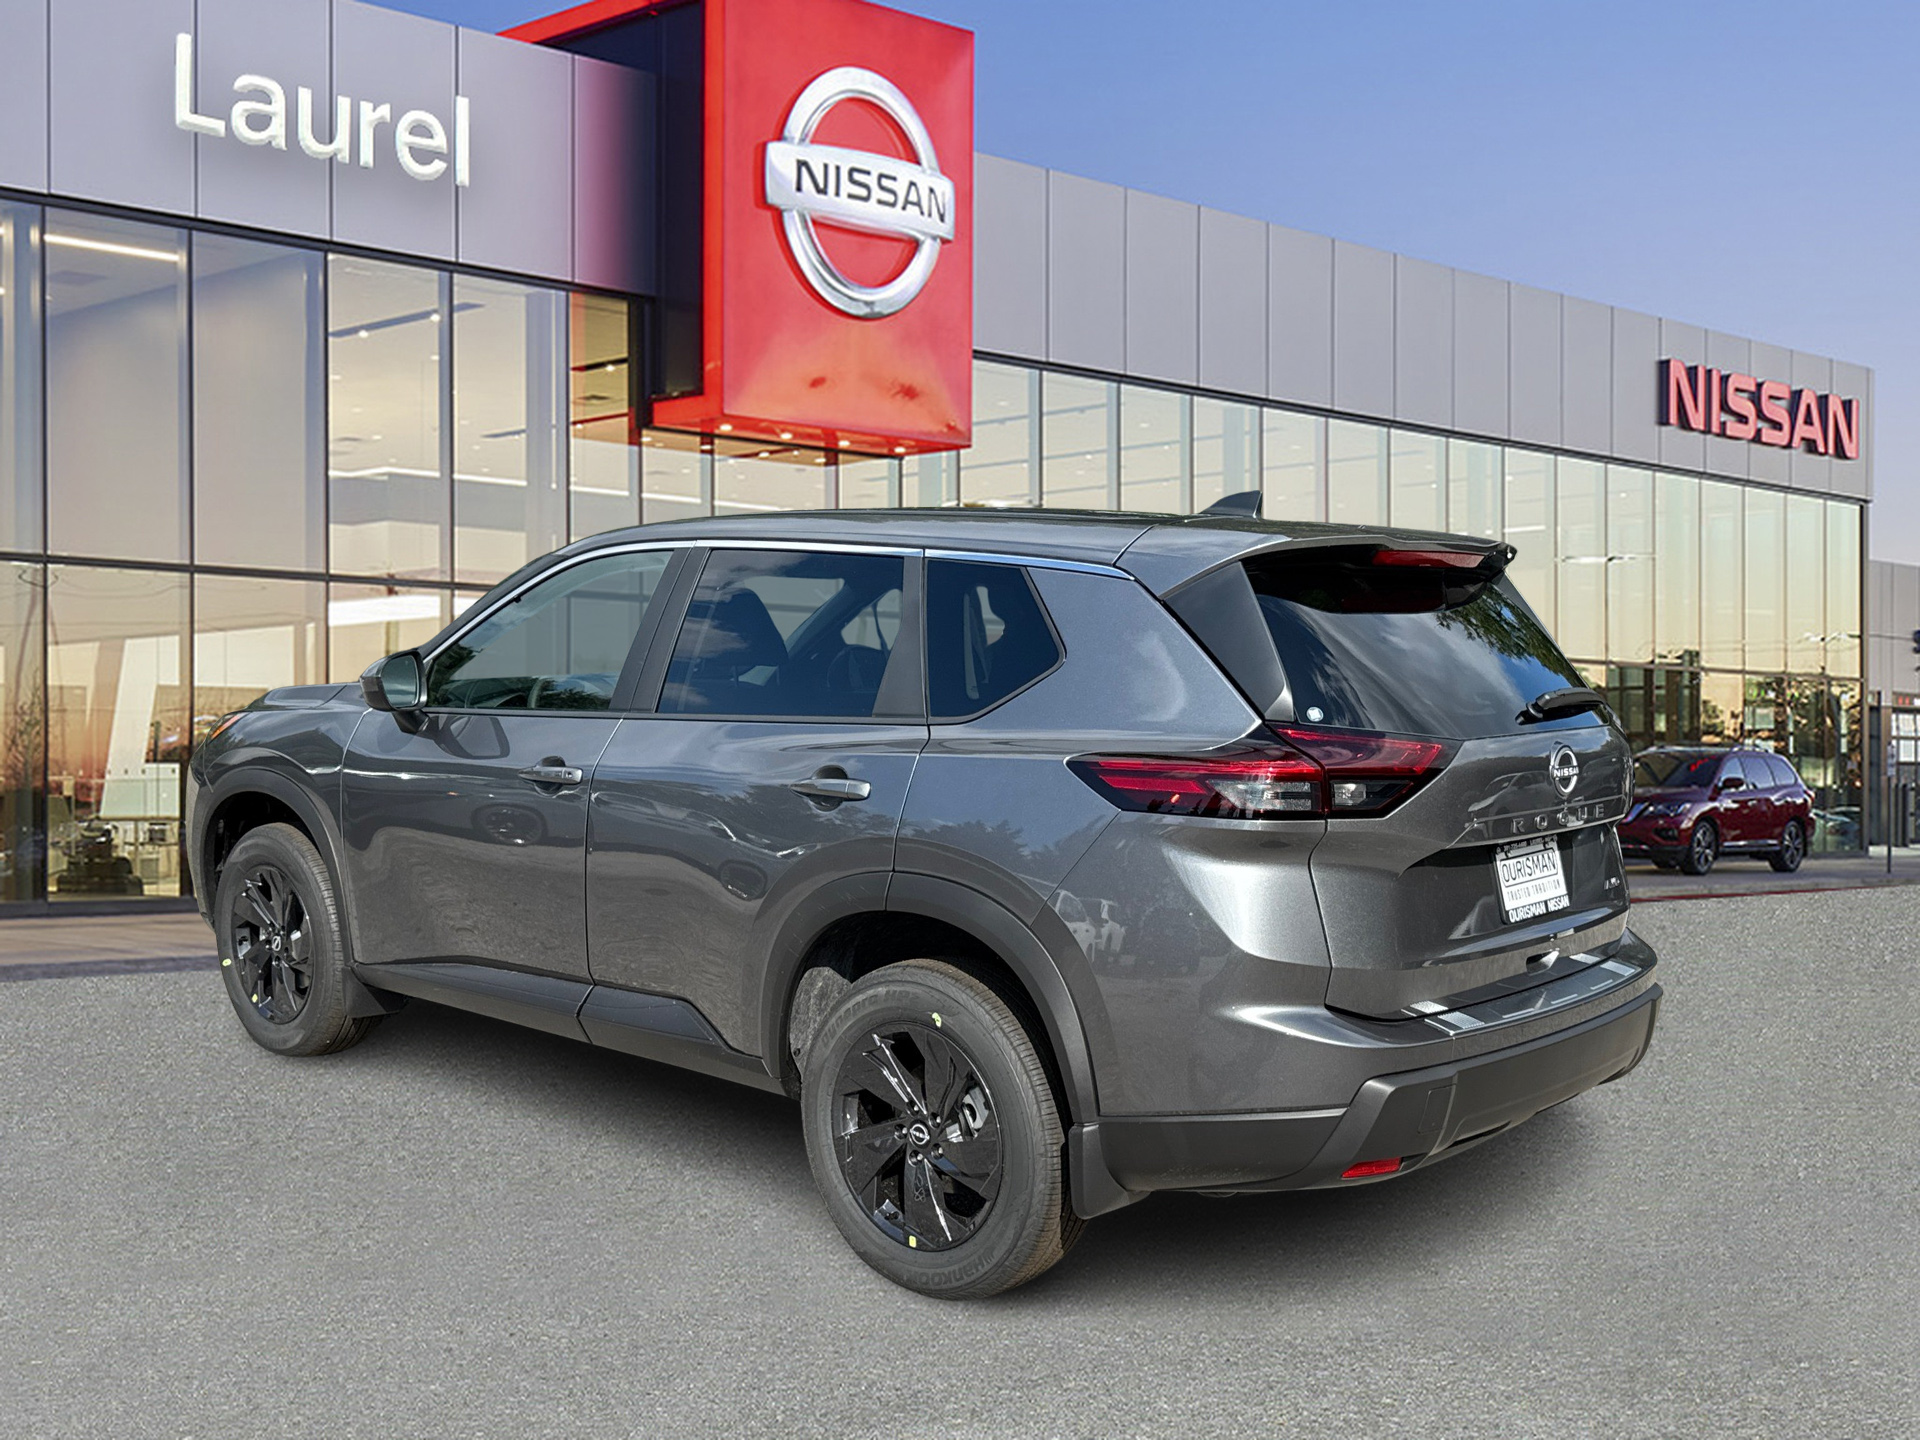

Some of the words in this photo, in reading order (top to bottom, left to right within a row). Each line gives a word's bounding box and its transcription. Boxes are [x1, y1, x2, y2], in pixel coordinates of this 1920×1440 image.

[175, 32, 470, 187] Laurel
[794, 158, 946, 223] NISSAN
[1659, 358, 1860, 460] NISSAN
[1553, 765, 1580, 777] NISSAN
[1511, 803, 1605, 834] ROGUE
[1501, 851, 1557, 883] OURISMAN
[1507, 886, 1531, 902] TRUSTED
[1508, 901, 1547, 923] OURISMAN
[1547, 894, 1570, 912] NISSAN
